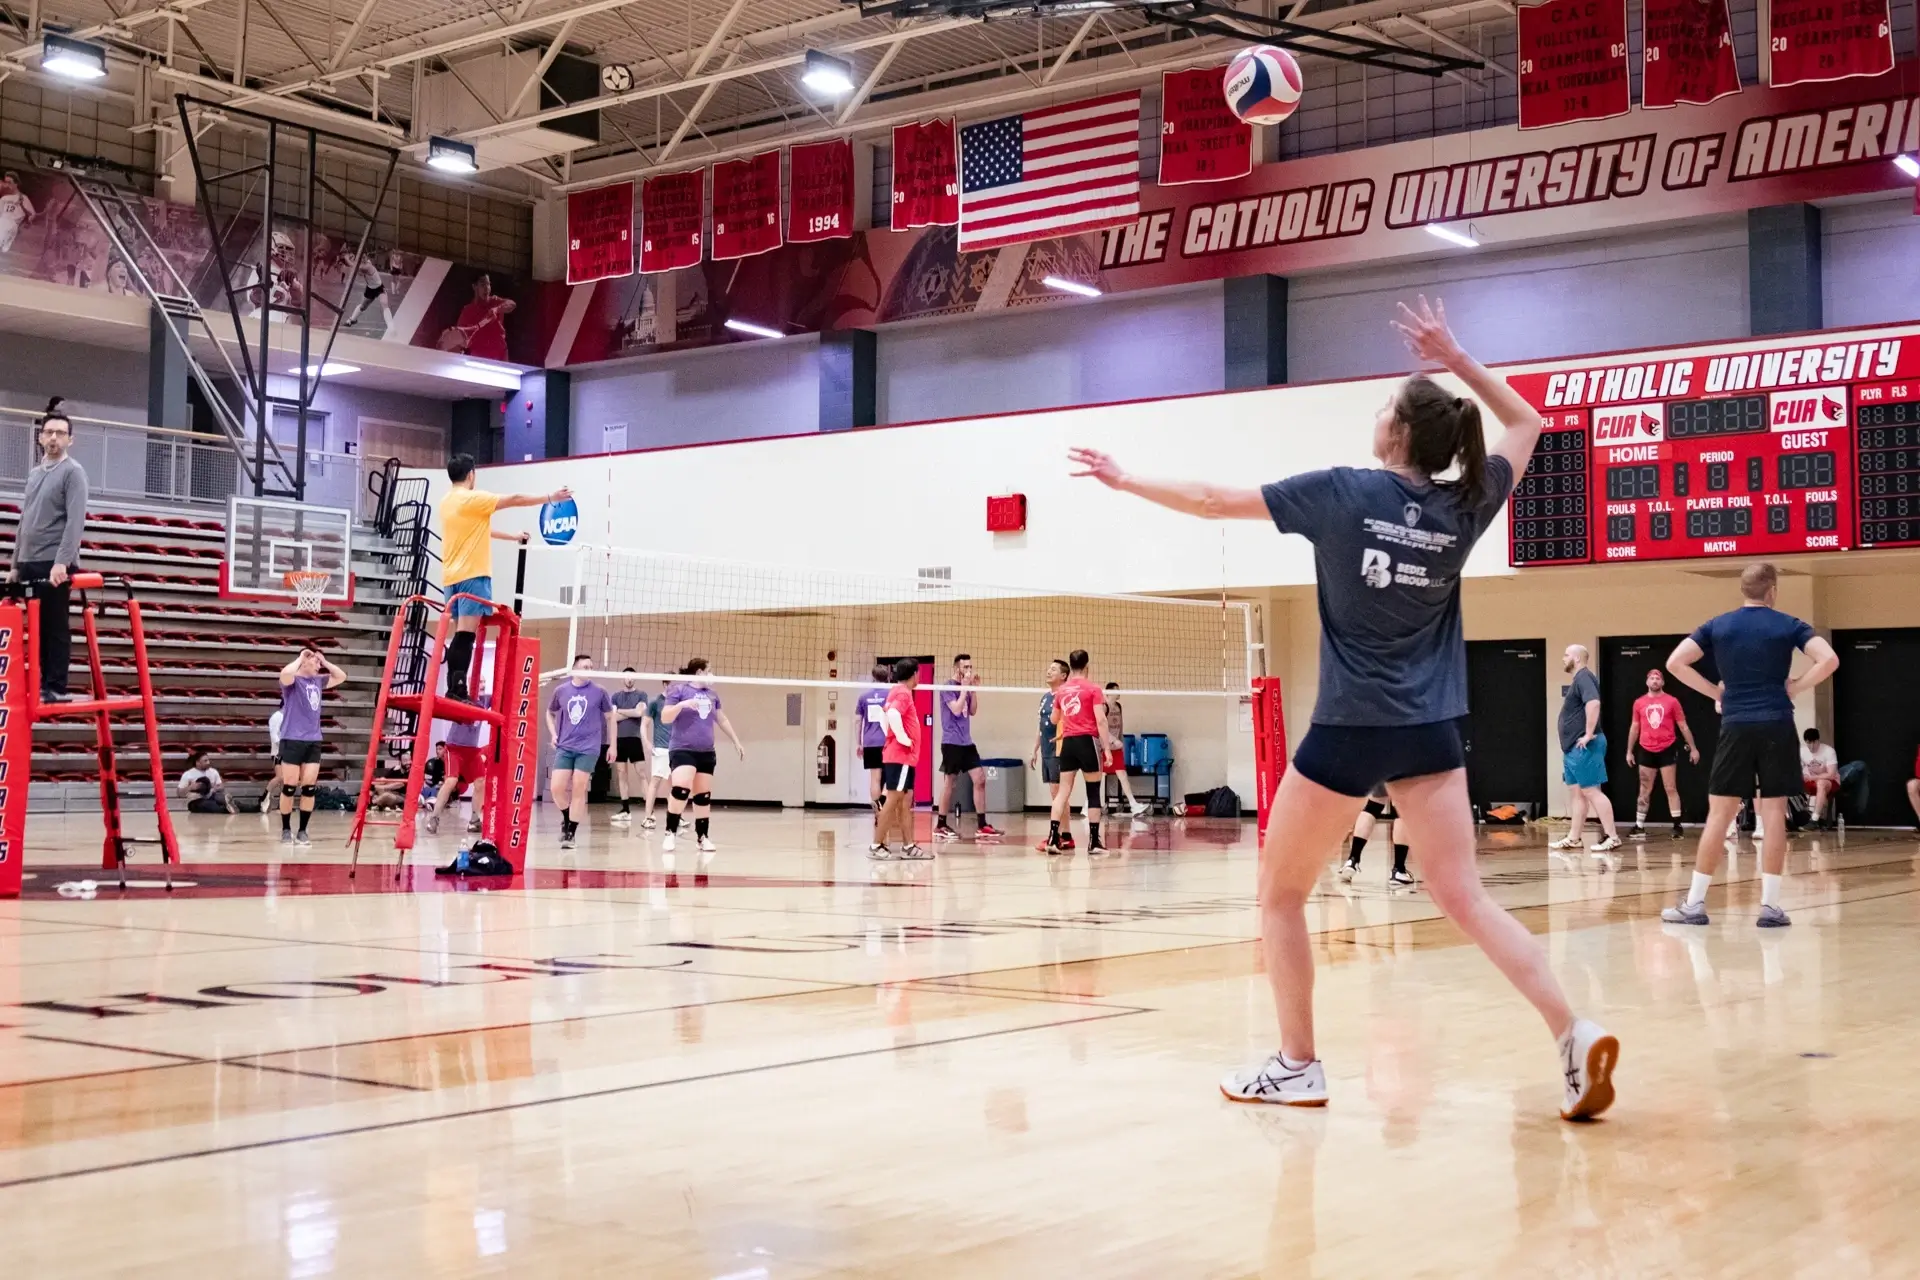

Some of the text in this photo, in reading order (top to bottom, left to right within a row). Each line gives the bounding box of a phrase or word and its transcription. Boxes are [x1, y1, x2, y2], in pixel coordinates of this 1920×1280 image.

[1611, 43, 1625, 58] 02
[1772, 37, 1788, 52] 20
[1646, 47, 1660, 62] 20
[1521, 59, 1533, 74] 20
[1162, 121, 1175, 135] 20
[894, 191, 905, 204] 20
[1102, 213, 1170, 266] THE
[1184, 181, 1371, 255] CATHOLIC
[1389, 138, 1653, 227] UNIVERSITY
[1667, 136, 1720, 184] OF
[716, 223, 725, 236] 20
[809, 213, 840, 234] 1994
[570, 239, 581, 251] 20
[644, 239, 653, 253] 20
[691, 232, 700, 246] 15
[1543, 341, 1902, 408] CATHOLIC UNIVERSITY
[1860, 385, 1908, 401] PLYR FLS
[1772, 397, 1815, 425] CUA
[1540, 414, 1580, 429] FLS PTS
[1595, 417, 1636, 440] CUA
[1780, 431, 1829, 450] GUEST
[1608, 445, 1659, 463] HOME
[1699, 450, 1735, 463] PERIOD
[1686, 496, 1753, 510] PLAYER FOUL
[1764, 493, 1793, 505] T.O.L.
[1805, 490, 1838, 503] FOULS
[1606, 502, 1637, 516] FOULS
[1647, 501, 1675, 513] T.O.L.
[543, 516, 577, 535] NCAA
[1703, 540, 1737, 553] MATCH
[1805, 535, 1839, 548] SCORE
[1606, 545, 1637, 558] SCORE
[1394, 573, 1430, 588] GROUP
[510, 655, 534, 849] CARDINALS
